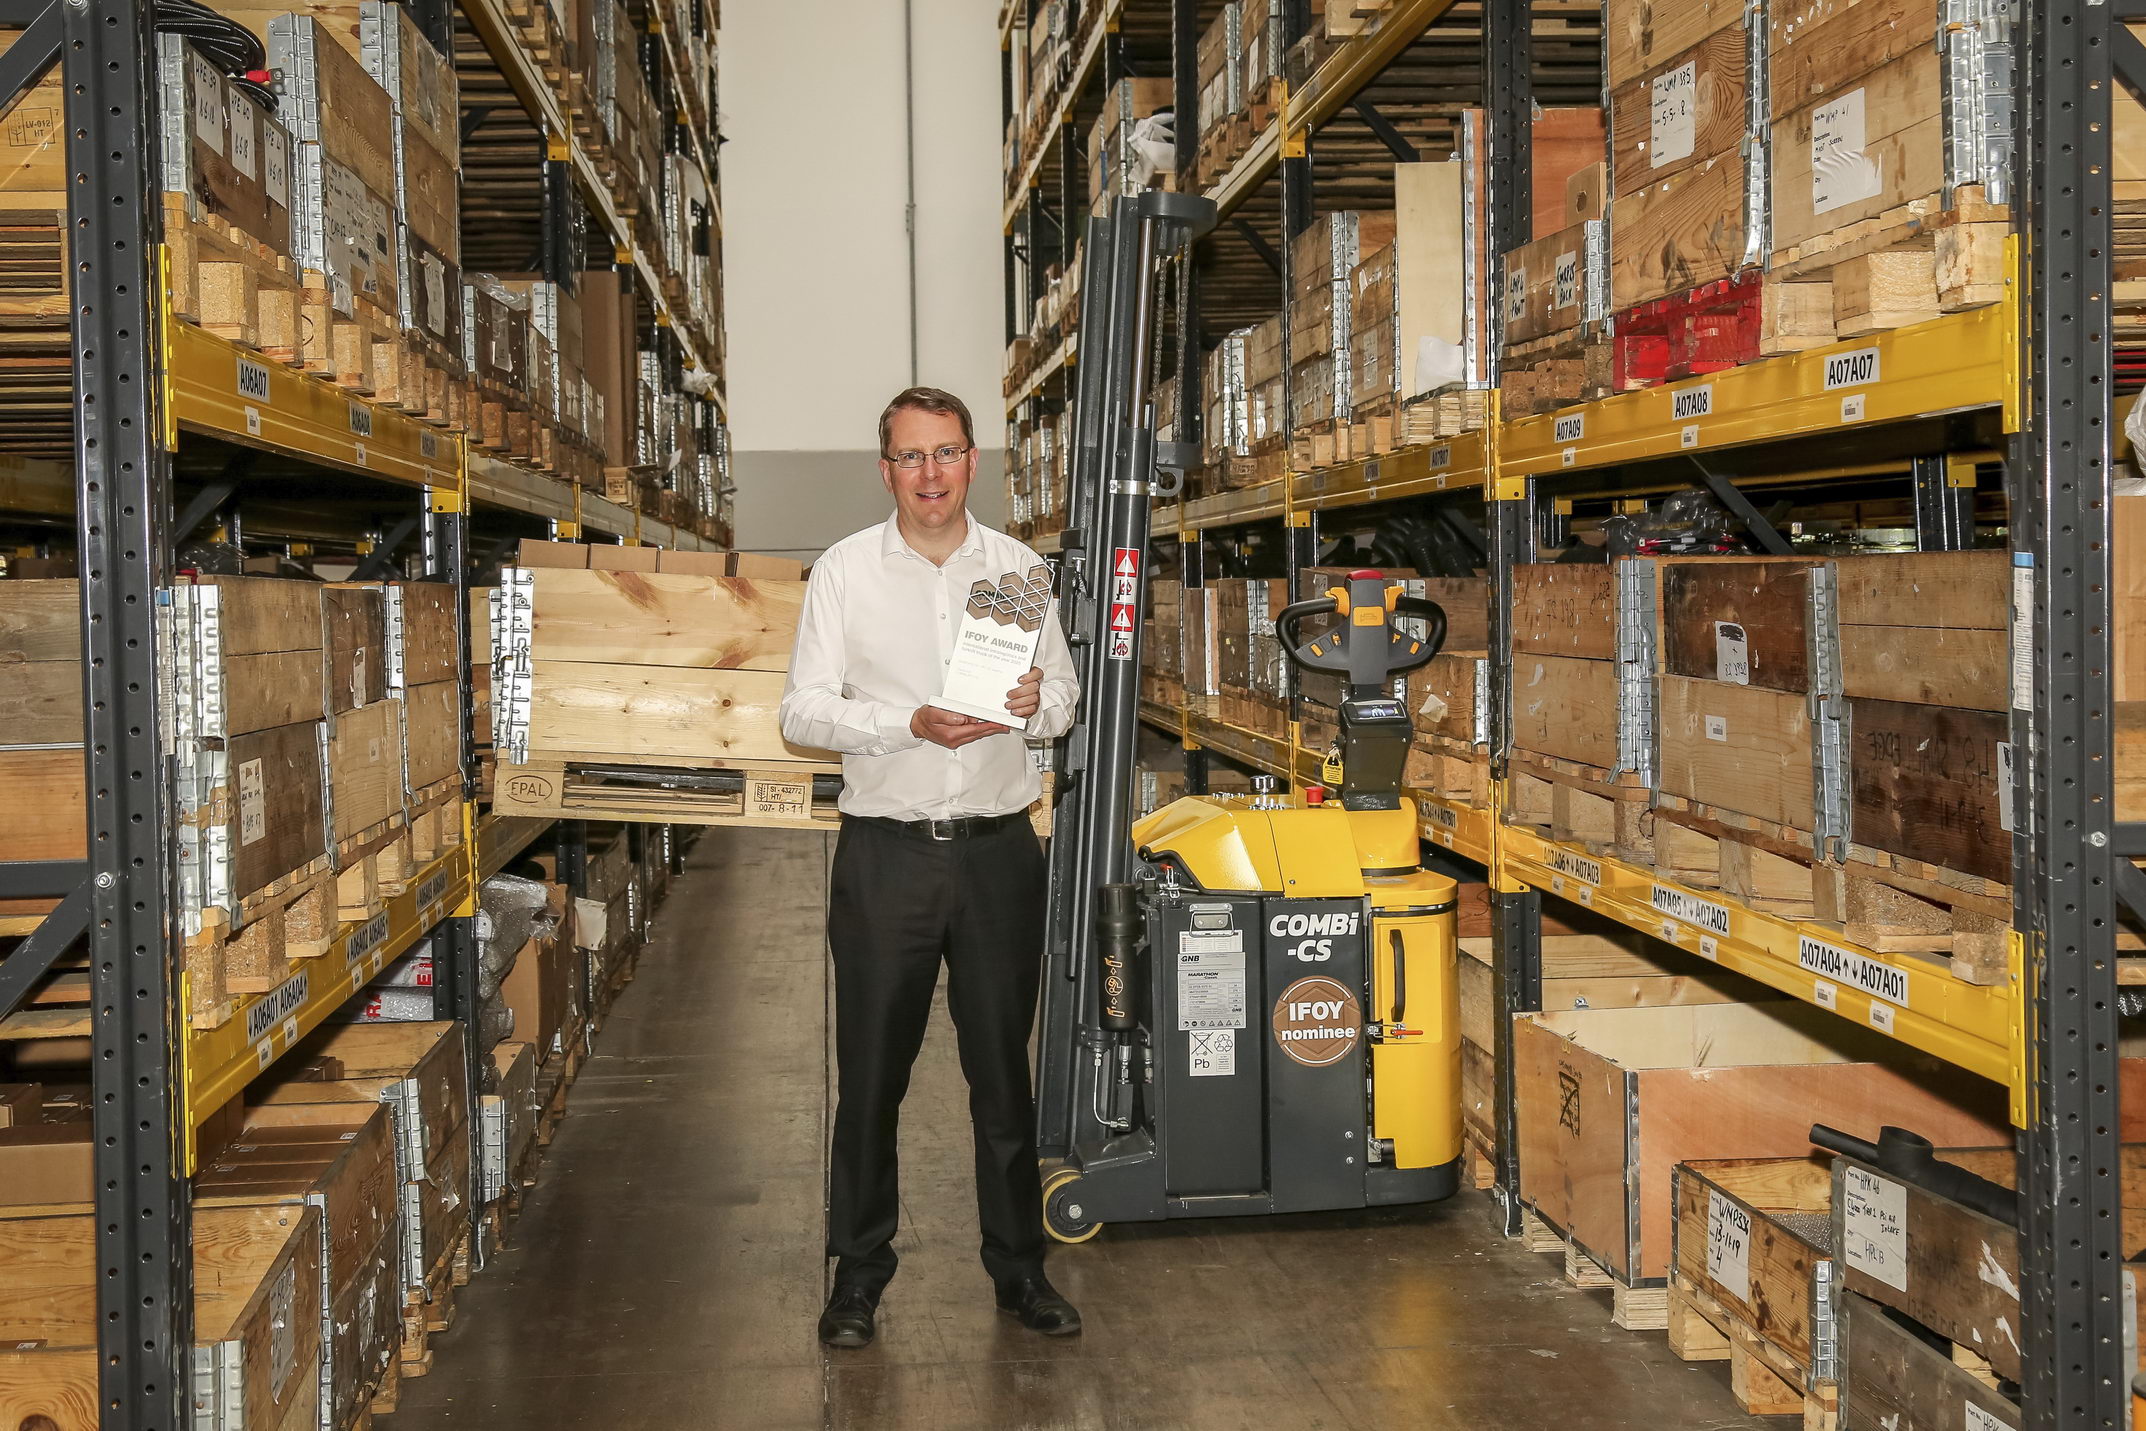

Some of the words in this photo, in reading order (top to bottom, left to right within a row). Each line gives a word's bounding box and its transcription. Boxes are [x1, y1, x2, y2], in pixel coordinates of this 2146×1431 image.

[34, 129, 44, 137] HT
[240, 362, 268, 398] A06A07
[1828, 354, 1874, 386] A07A07
[1675, 391, 1708, 417] A07A08
[1556, 419, 1581, 441] A07A09
[964, 630, 989, 643] IFOY
[990, 637, 1029, 653] AWARD
[510, 781, 546, 797] EPAL
[1544, 847, 1566, 872] A07A06
[1575, 860, 1600, 884] A07A03
[1653, 887, 1682, 916] A07A05
[1695, 904, 1727, 932] A07A02
[1269, 912, 1359, 937] COMBi
[1287, 939, 1332, 962] -CS
[1800, 939, 1842, 976] A07A04
[1860, 964, 1905, 1001] A07A01
[253, 1002, 278, 1037] A06A01
[280, 986, 304, 1016] A06A04
[1289, 1001, 1344, 1021] IFOY
[1281, 1025, 1356, 1041] nominee
[1194, 1059, 1210, 1069] Pb
